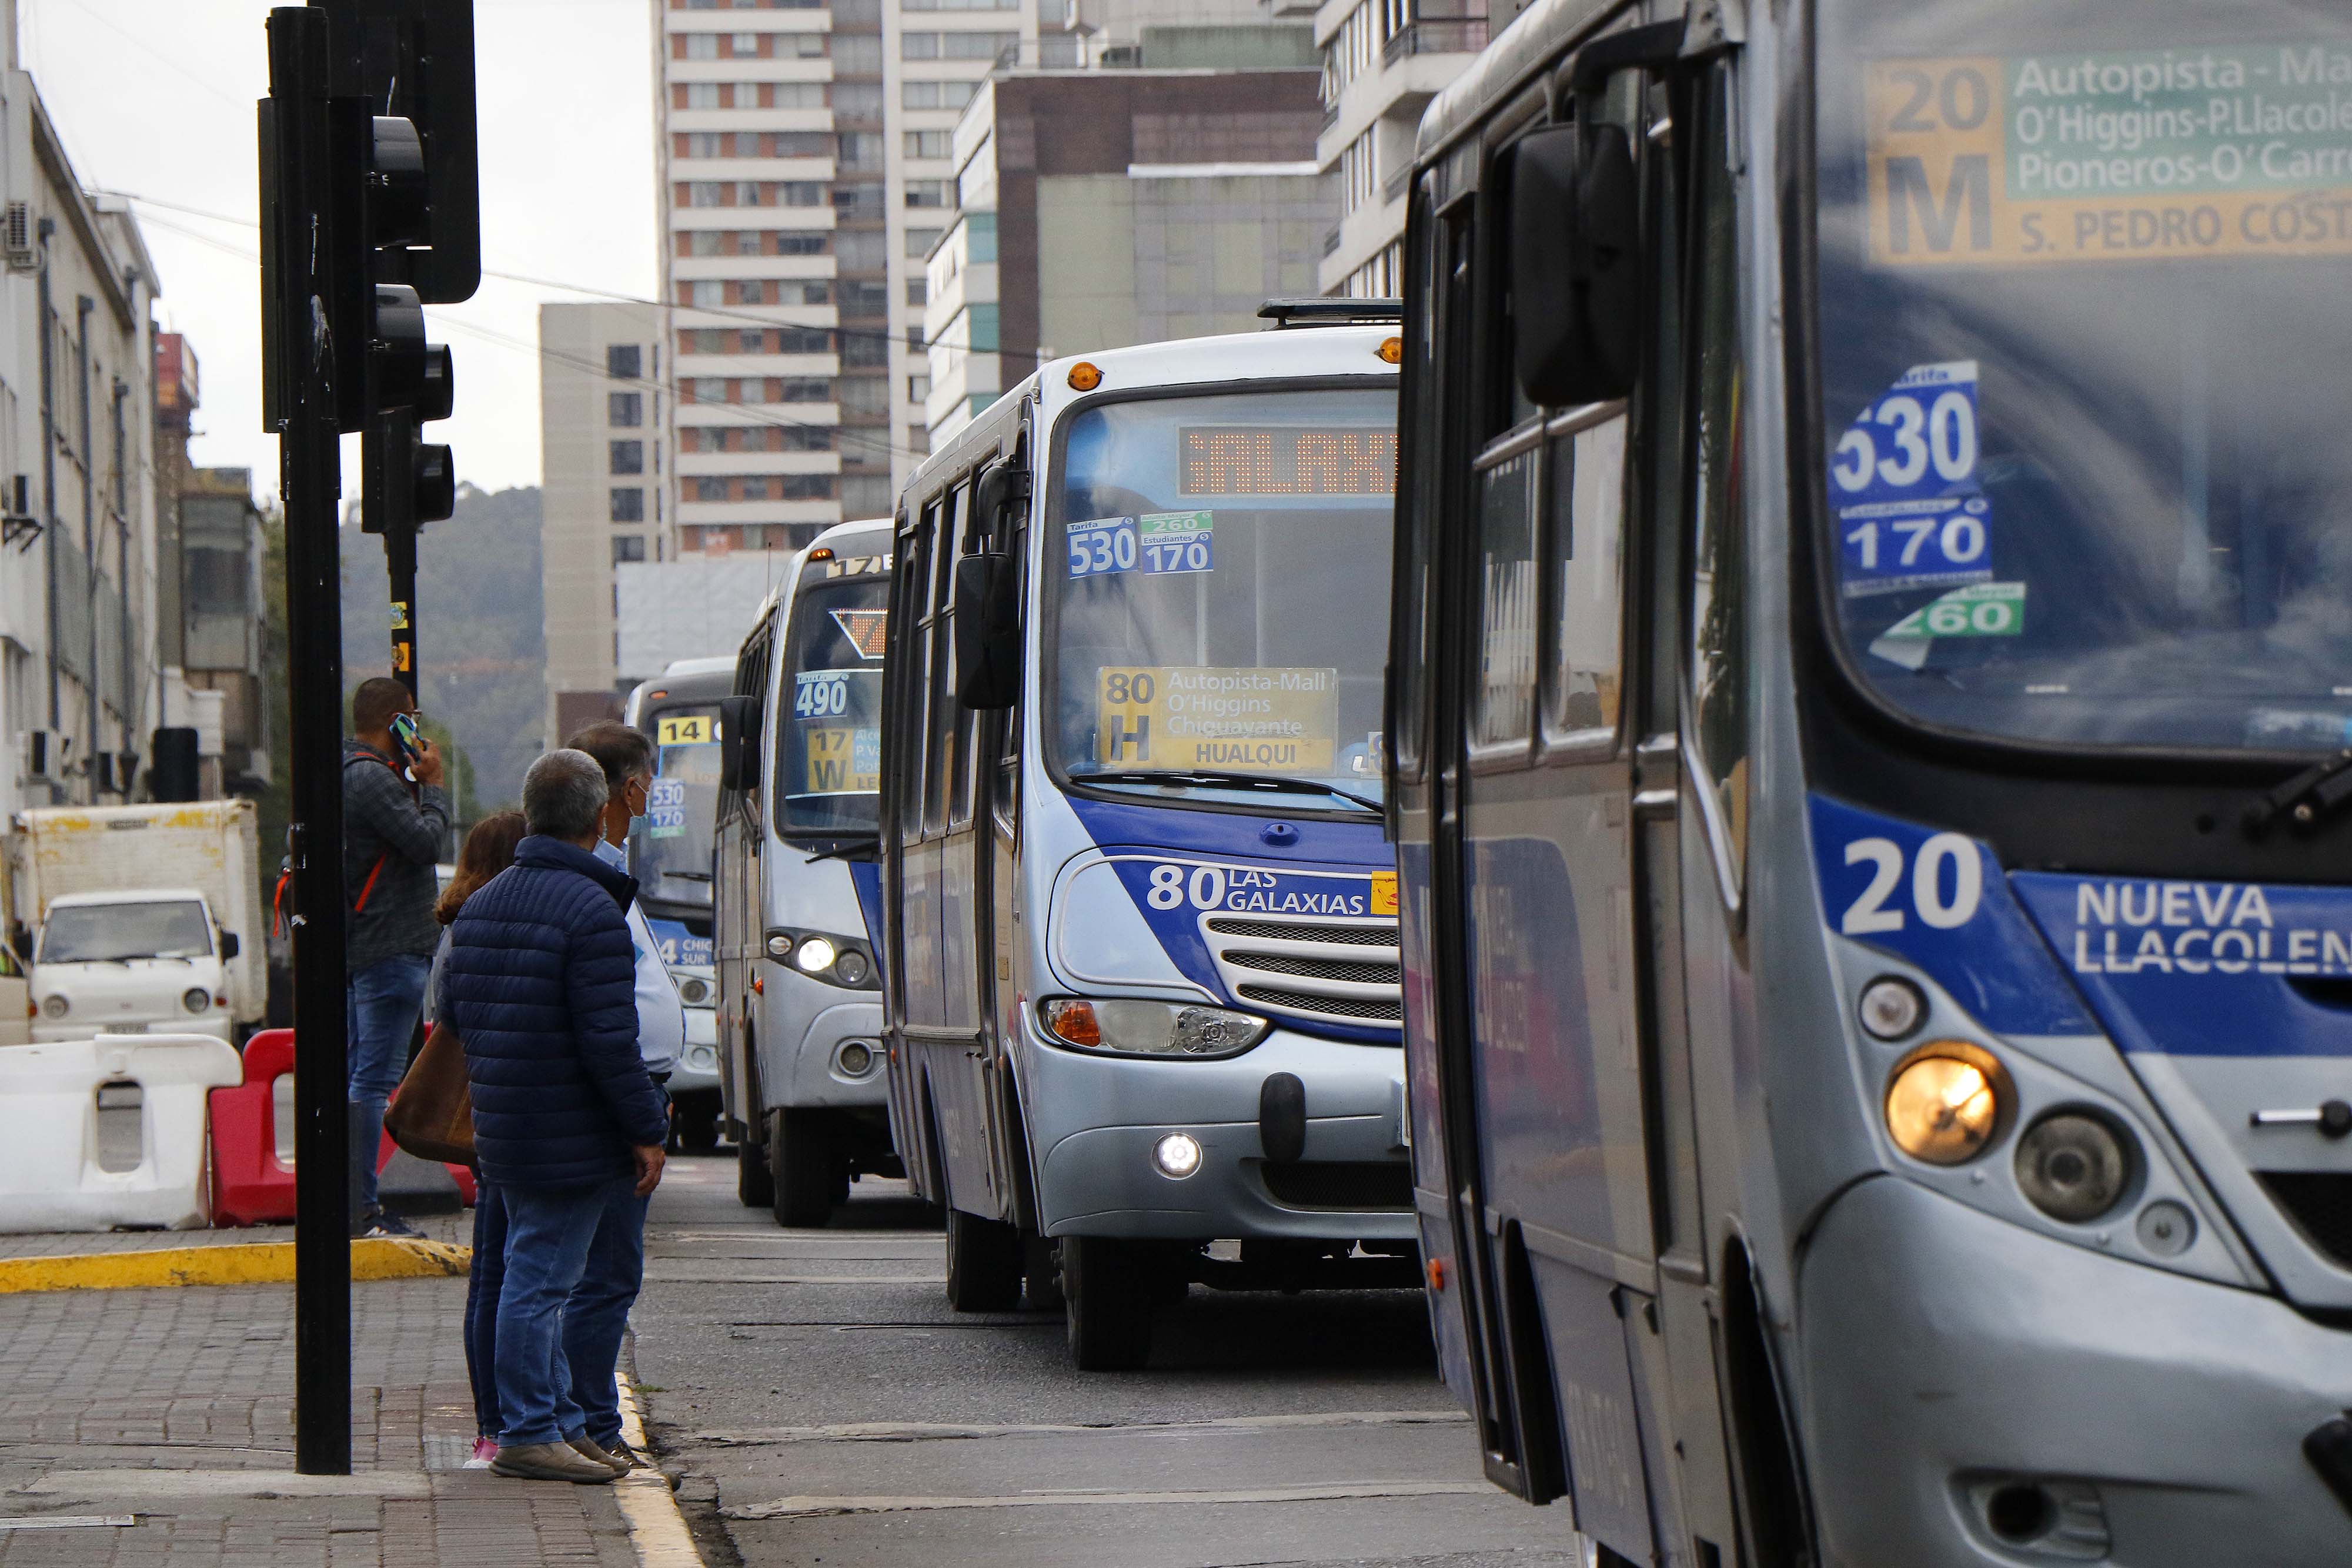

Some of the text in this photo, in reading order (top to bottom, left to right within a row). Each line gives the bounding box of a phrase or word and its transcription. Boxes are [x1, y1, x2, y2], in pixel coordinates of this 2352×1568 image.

[2014, 52, 2244, 100] Autopista
[1888, 68, 1990, 133] 20
[2019, 141, 2352, 190] Pioneros-O'Carr
[1886, 154, 1993, 254] M
[2021, 212, 2057, 253] S.
[2075, 206, 2223, 251] PEDRO
[1898, 367, 1949, 387] arifa
[1832, 391, 1975, 492] 530
[1070, 521, 1098, 531] Tarifa
[1144, 534, 1192, 544] Estudiantes
[1152, 519, 1198, 531] 260
[1070, 528, 1136, 574] 530
[1846, 516, 1986, 569] 170
[1146, 543, 1209, 572] 170
[1106, 673, 1155, 704] 80
[1168, 671, 1326, 694] Autopista-Mall
[796, 681, 847, 717] 490
[1167, 694, 1271, 717] O'Higgins
[665, 721, 700, 740] 14
[815, 731, 847, 751] 17
[1110, 715, 1150, 761] H
[1196, 743, 1296, 766] HUALQUI
[813, 759, 847, 790] W
[652, 784, 684, 806] 530
[653, 811, 683, 827] 170
[1147, 864, 1277, 911] 80 LAS
[1840, 831, 2274, 937] 20 NUEVA
[1227, 891, 1364, 915] GALAXIAS
[659, 938, 677, 964] 4
[681, 953, 706, 965] SUR
